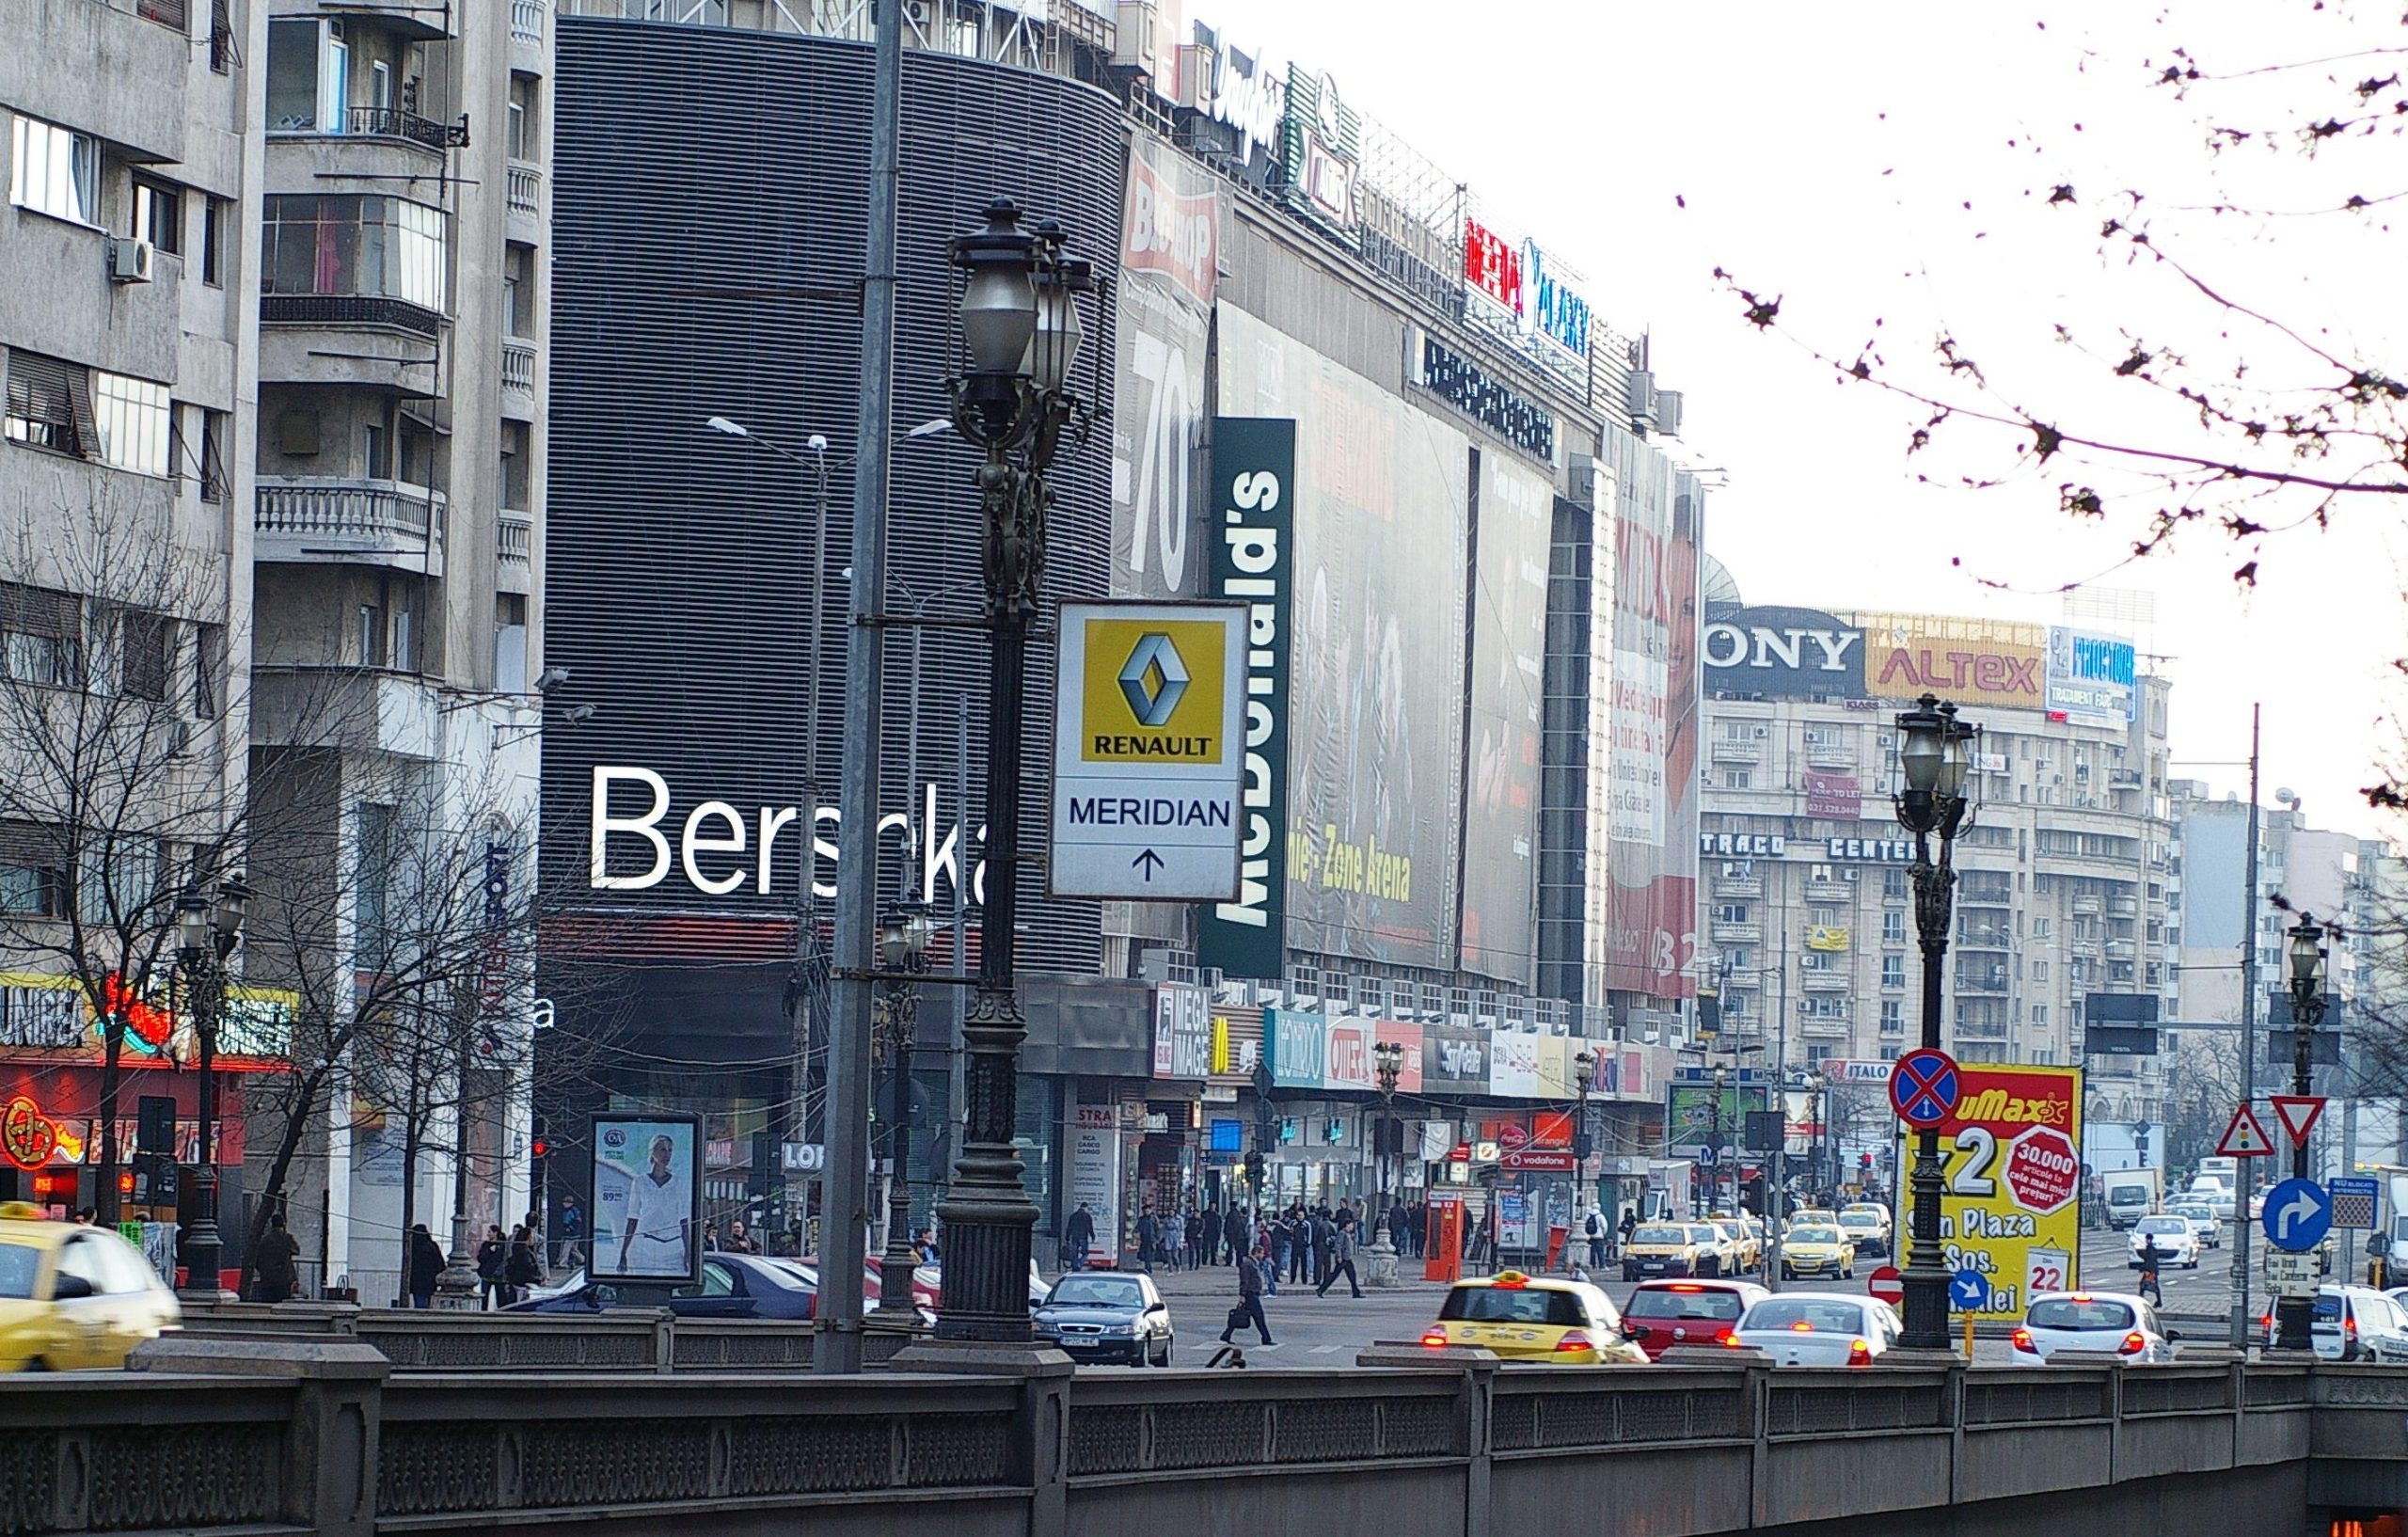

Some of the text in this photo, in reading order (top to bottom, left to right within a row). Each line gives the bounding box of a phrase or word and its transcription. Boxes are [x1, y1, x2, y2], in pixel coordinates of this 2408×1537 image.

[1703, 623, 1860, 671] ONY
[1216, 470, 1280, 927] McDonald's
[1094, 736, 1212, 756] RENAULT
[1069, 797, 1230, 827] MERIDIAN
[591, 765, 988, 906] Bersk
[1322, 823, 1363, 893] Zone
[1366, 833, 1411, 903] Arena
[1176, 989, 1209, 1033] MEGA
[1173, 1035, 1209, 1077] IMAGE
[1524, 1155, 1565, 1165] vodafone
[2018, 1143, 2074, 1175] 30.000
[2009, 1169, 2069, 1197] cele mai mici
[1962, 1208, 2036, 1240] Plaza
[1945, 1244, 1999, 1274] Sos.
[2031, 1266, 2061, 1291] 22
